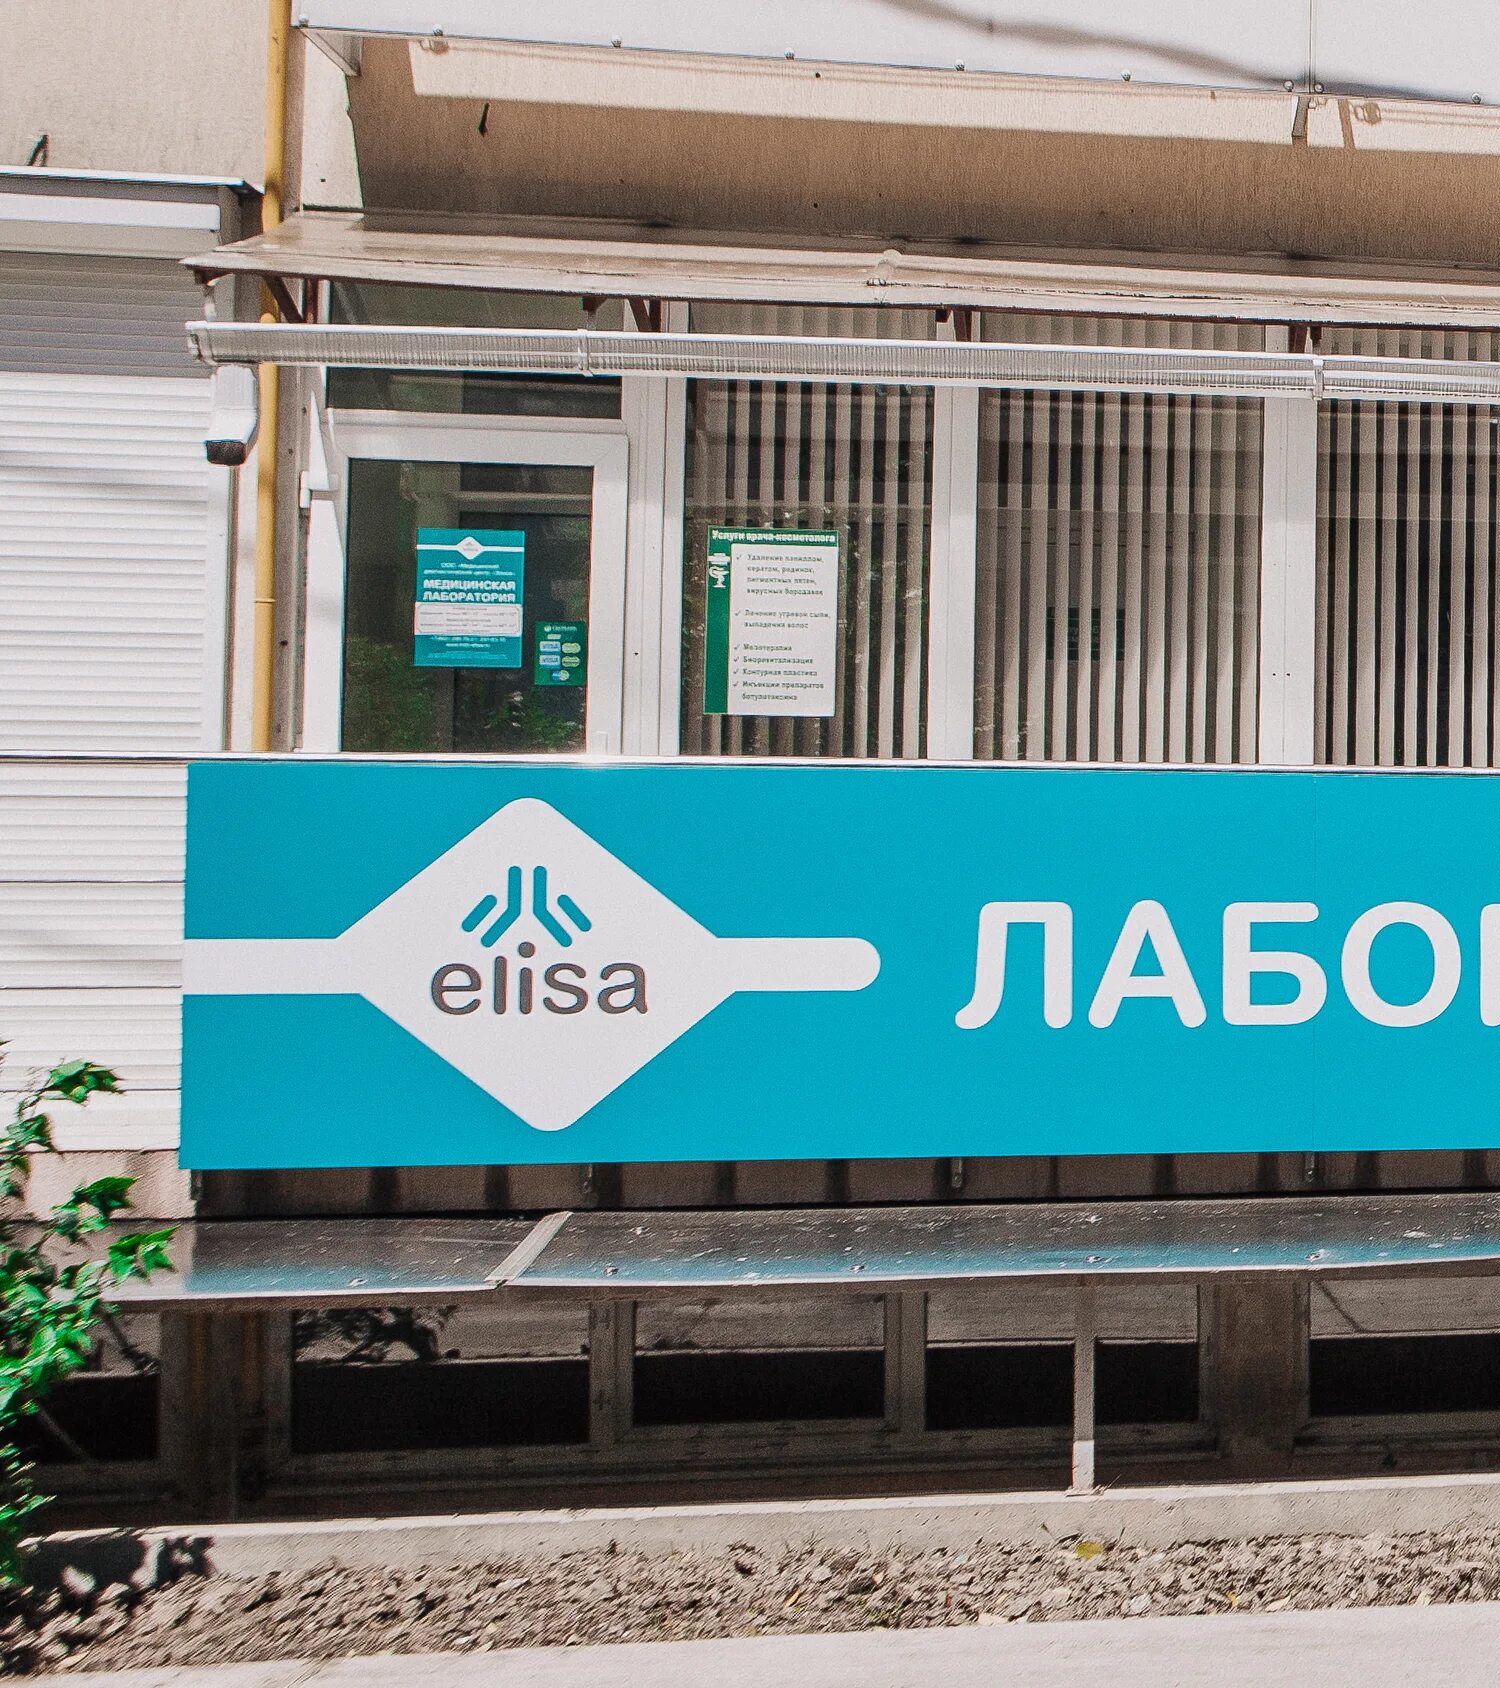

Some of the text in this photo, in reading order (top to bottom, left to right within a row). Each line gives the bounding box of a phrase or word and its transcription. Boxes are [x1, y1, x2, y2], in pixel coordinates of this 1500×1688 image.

[712, 530, 836, 543] Услуги врача-косметолога
[747, 554, 784, 562] Удаление
[423, 579, 516, 591] МЕДИЦИНСКАЯ
[422, 591, 516, 602] ЛАБОРАТОРИЯ
[747, 588, 783, 596] вирусных
[744, 609, 777, 617] Лечение
[743, 643, 793, 652] Мезотерапия
[743, 656, 814, 665] Биоревитализация
[742, 668, 818, 677] Контурная пластика
[742, 680, 825, 690] Инъекции препаратов
[431, 942, 647, 1015] elisa
